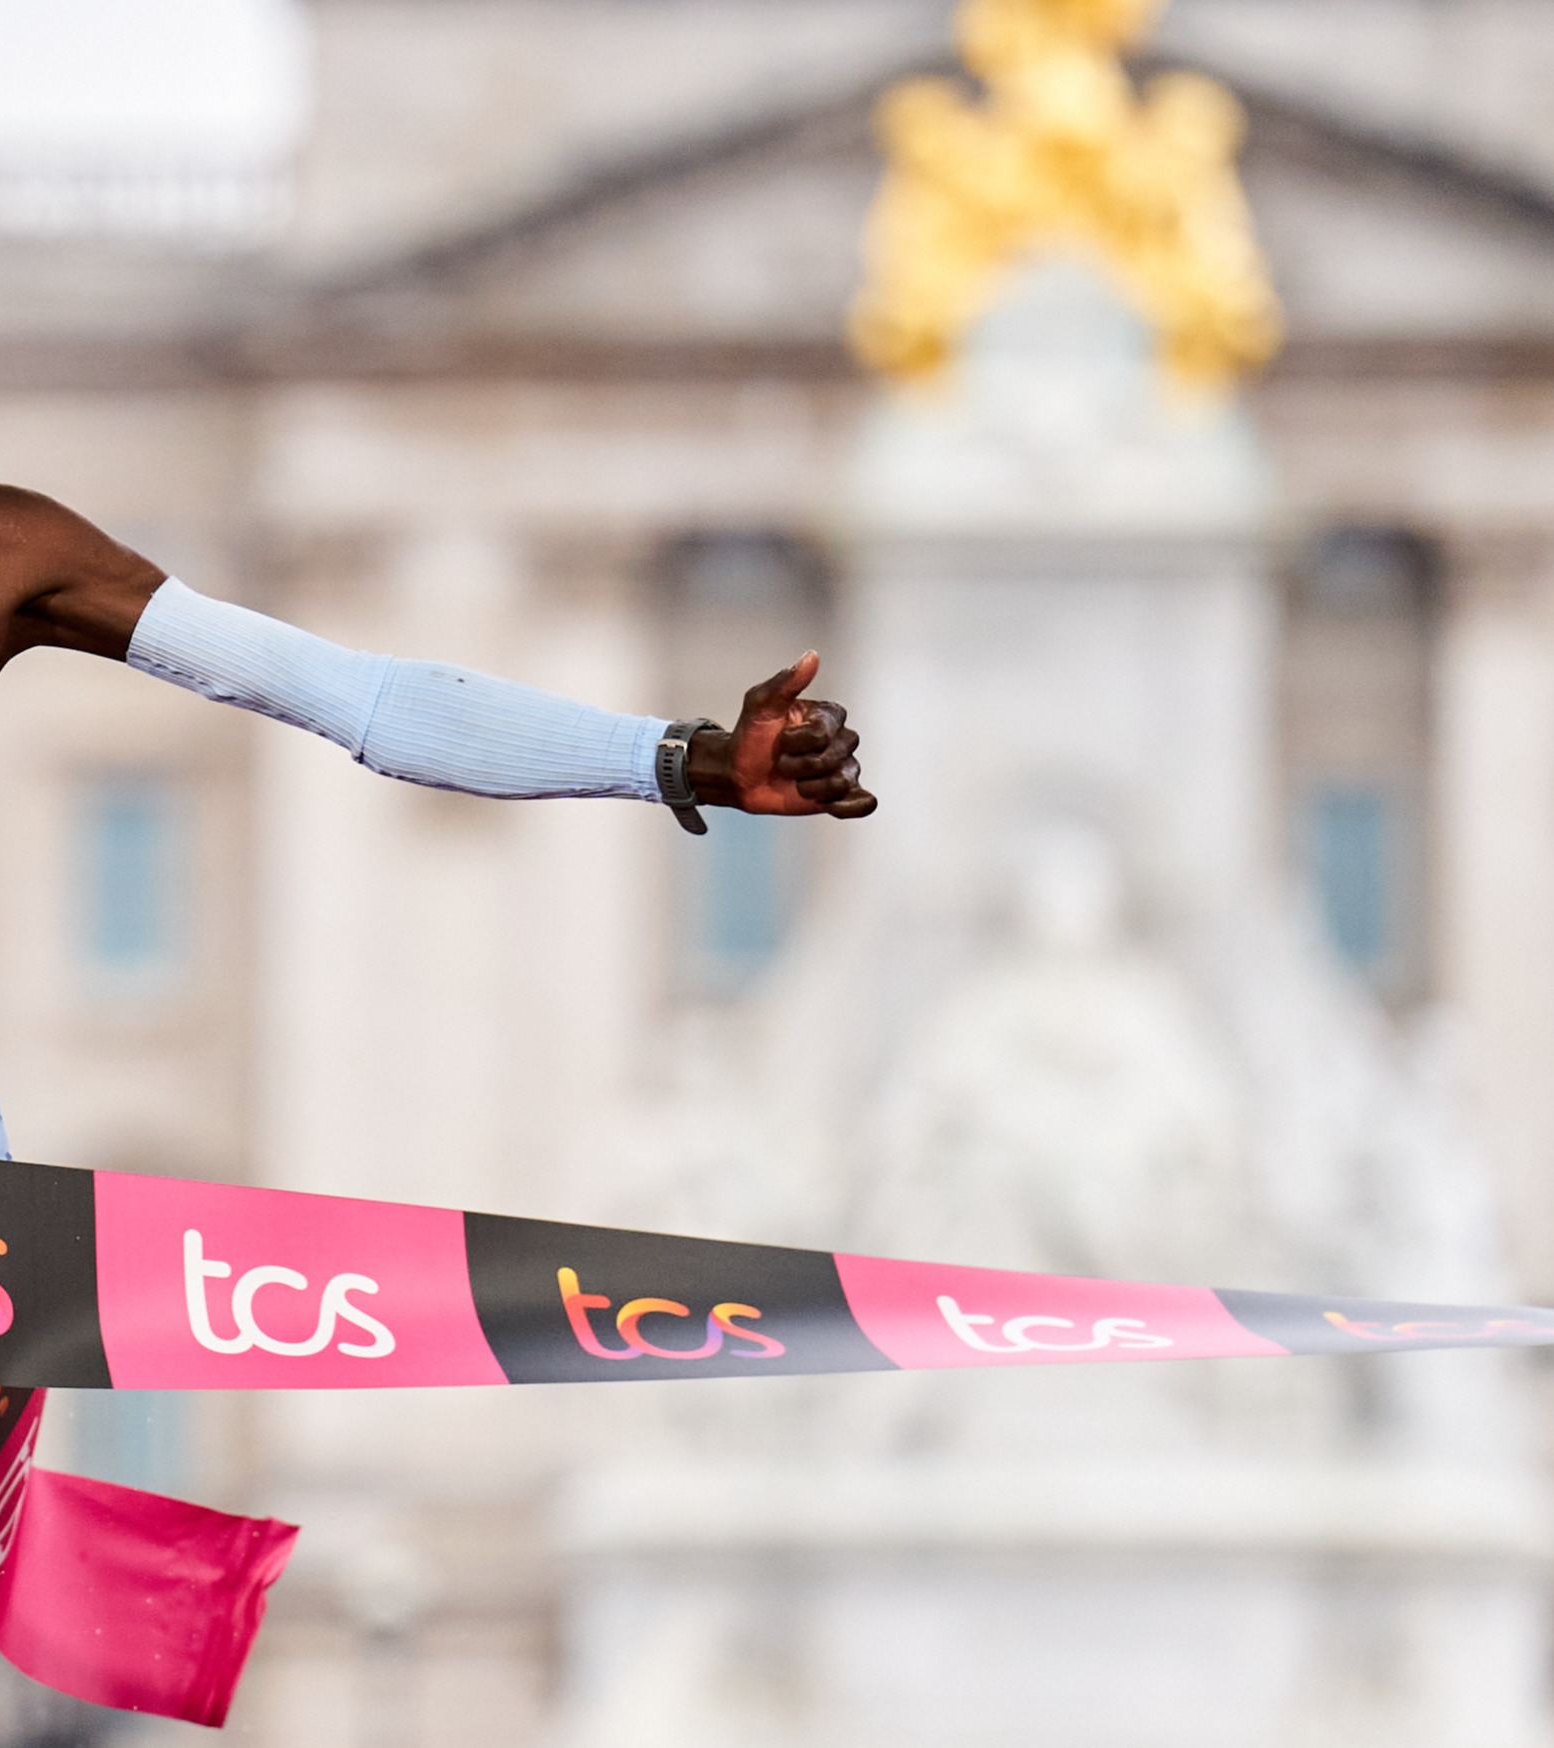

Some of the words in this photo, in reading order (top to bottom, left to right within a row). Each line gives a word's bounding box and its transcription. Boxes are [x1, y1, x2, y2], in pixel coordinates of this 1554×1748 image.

[183, 1229, 396, 1359] tcs
[557, 1266, 787, 1360] tcs
[937, 1294, 1175, 1353] tcs
